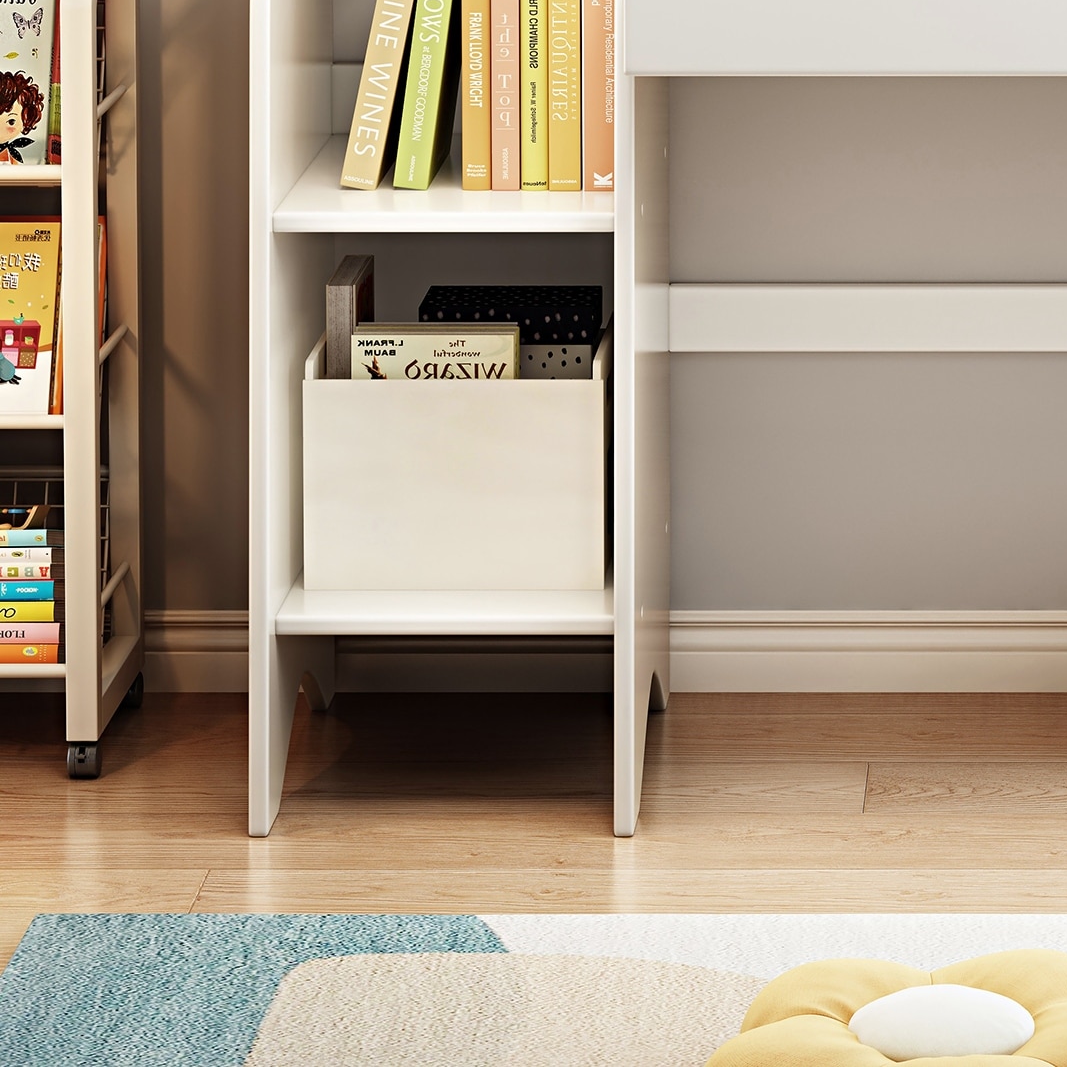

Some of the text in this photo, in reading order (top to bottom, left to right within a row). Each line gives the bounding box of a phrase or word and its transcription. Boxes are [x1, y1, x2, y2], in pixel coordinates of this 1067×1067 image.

[423, 46, 430, 54] at
[469, 13, 483, 107] FRANK LLOYD WRIGHT
[605, 33, 614, 75] Residential
[416, 55, 431, 96] BERGDORF
[354, 62, 393, 158] WINES
[411, 97, 426, 141] GOODMAN
[605, 77, 614, 123] Architecture
